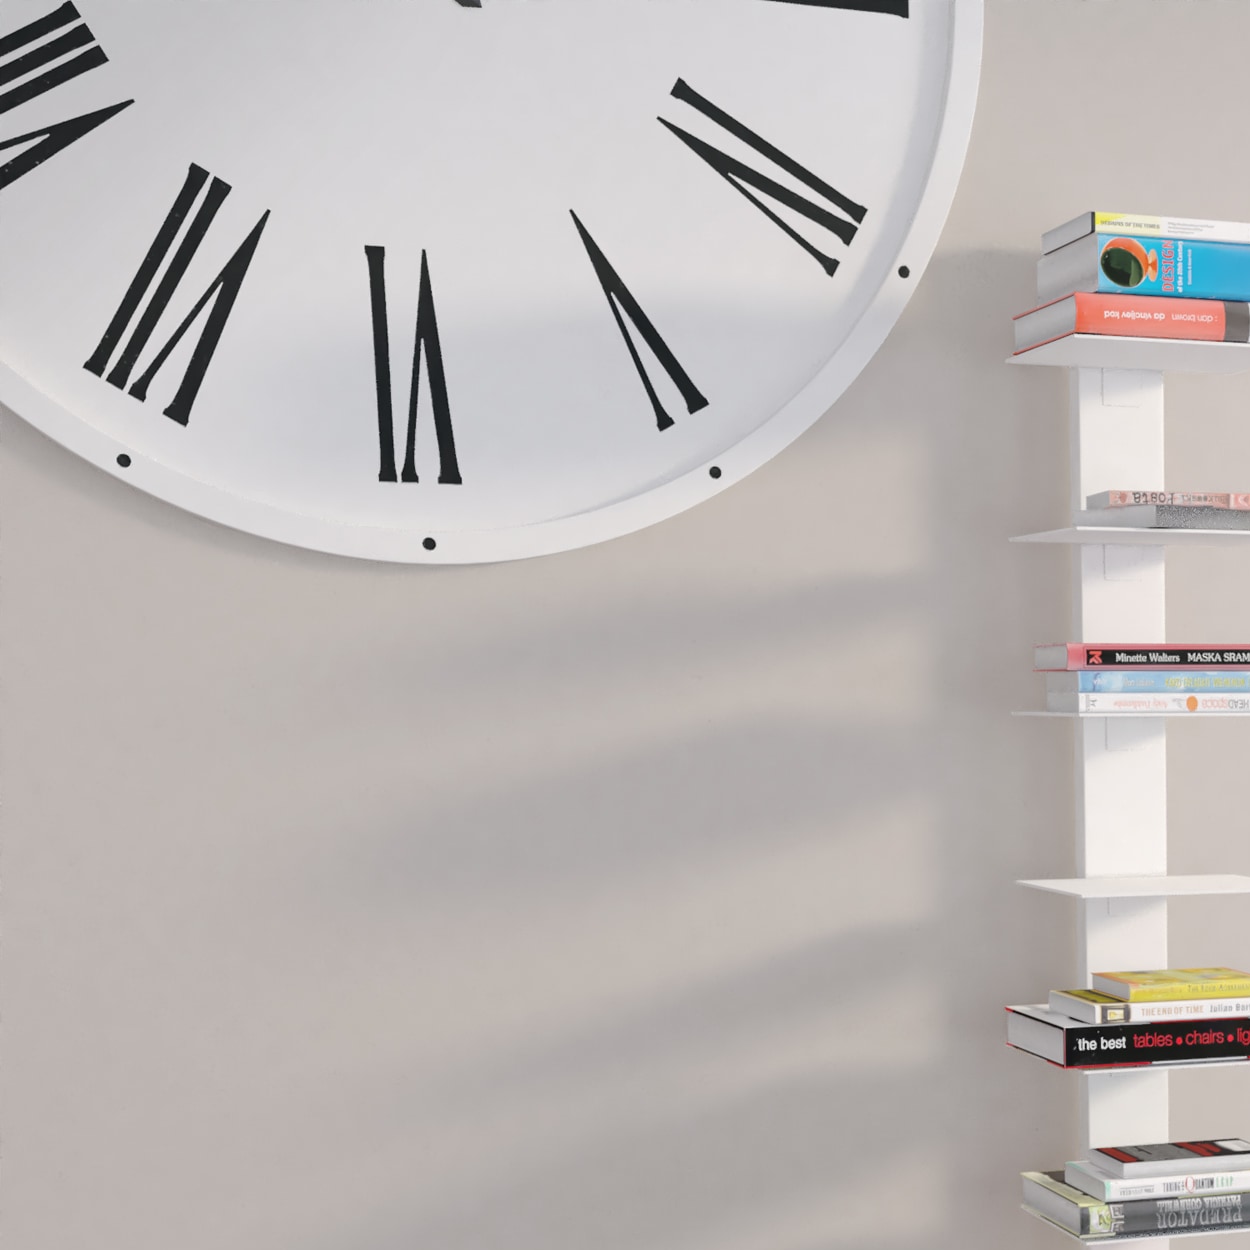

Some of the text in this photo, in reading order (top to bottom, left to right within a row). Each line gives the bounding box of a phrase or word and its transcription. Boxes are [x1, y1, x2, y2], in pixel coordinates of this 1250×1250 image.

[1162, 240, 1175, 292] DESIGN
[1104, 309, 1214, 323] dan brown da vincijev kod
[1115, 652, 1147, 662] Minette
[1149, 652, 1180, 662] Walters
[1187, 652, 1221, 662] MASKA
[1142, 1008, 1157, 1016] THE
[1157, 1007, 1171, 1015] END
[1185, 1005, 1204, 1014] TIME
[1210, 1003, 1232, 1013] Julian
[1078, 1038, 1097, 1051] the
[1100, 1036, 1127, 1050] best
[1133, 1032, 1173, 1048] tables
[1185, 1030, 1224, 1045] chairs
[1156, 1206, 1242, 1229] PREDATOR
